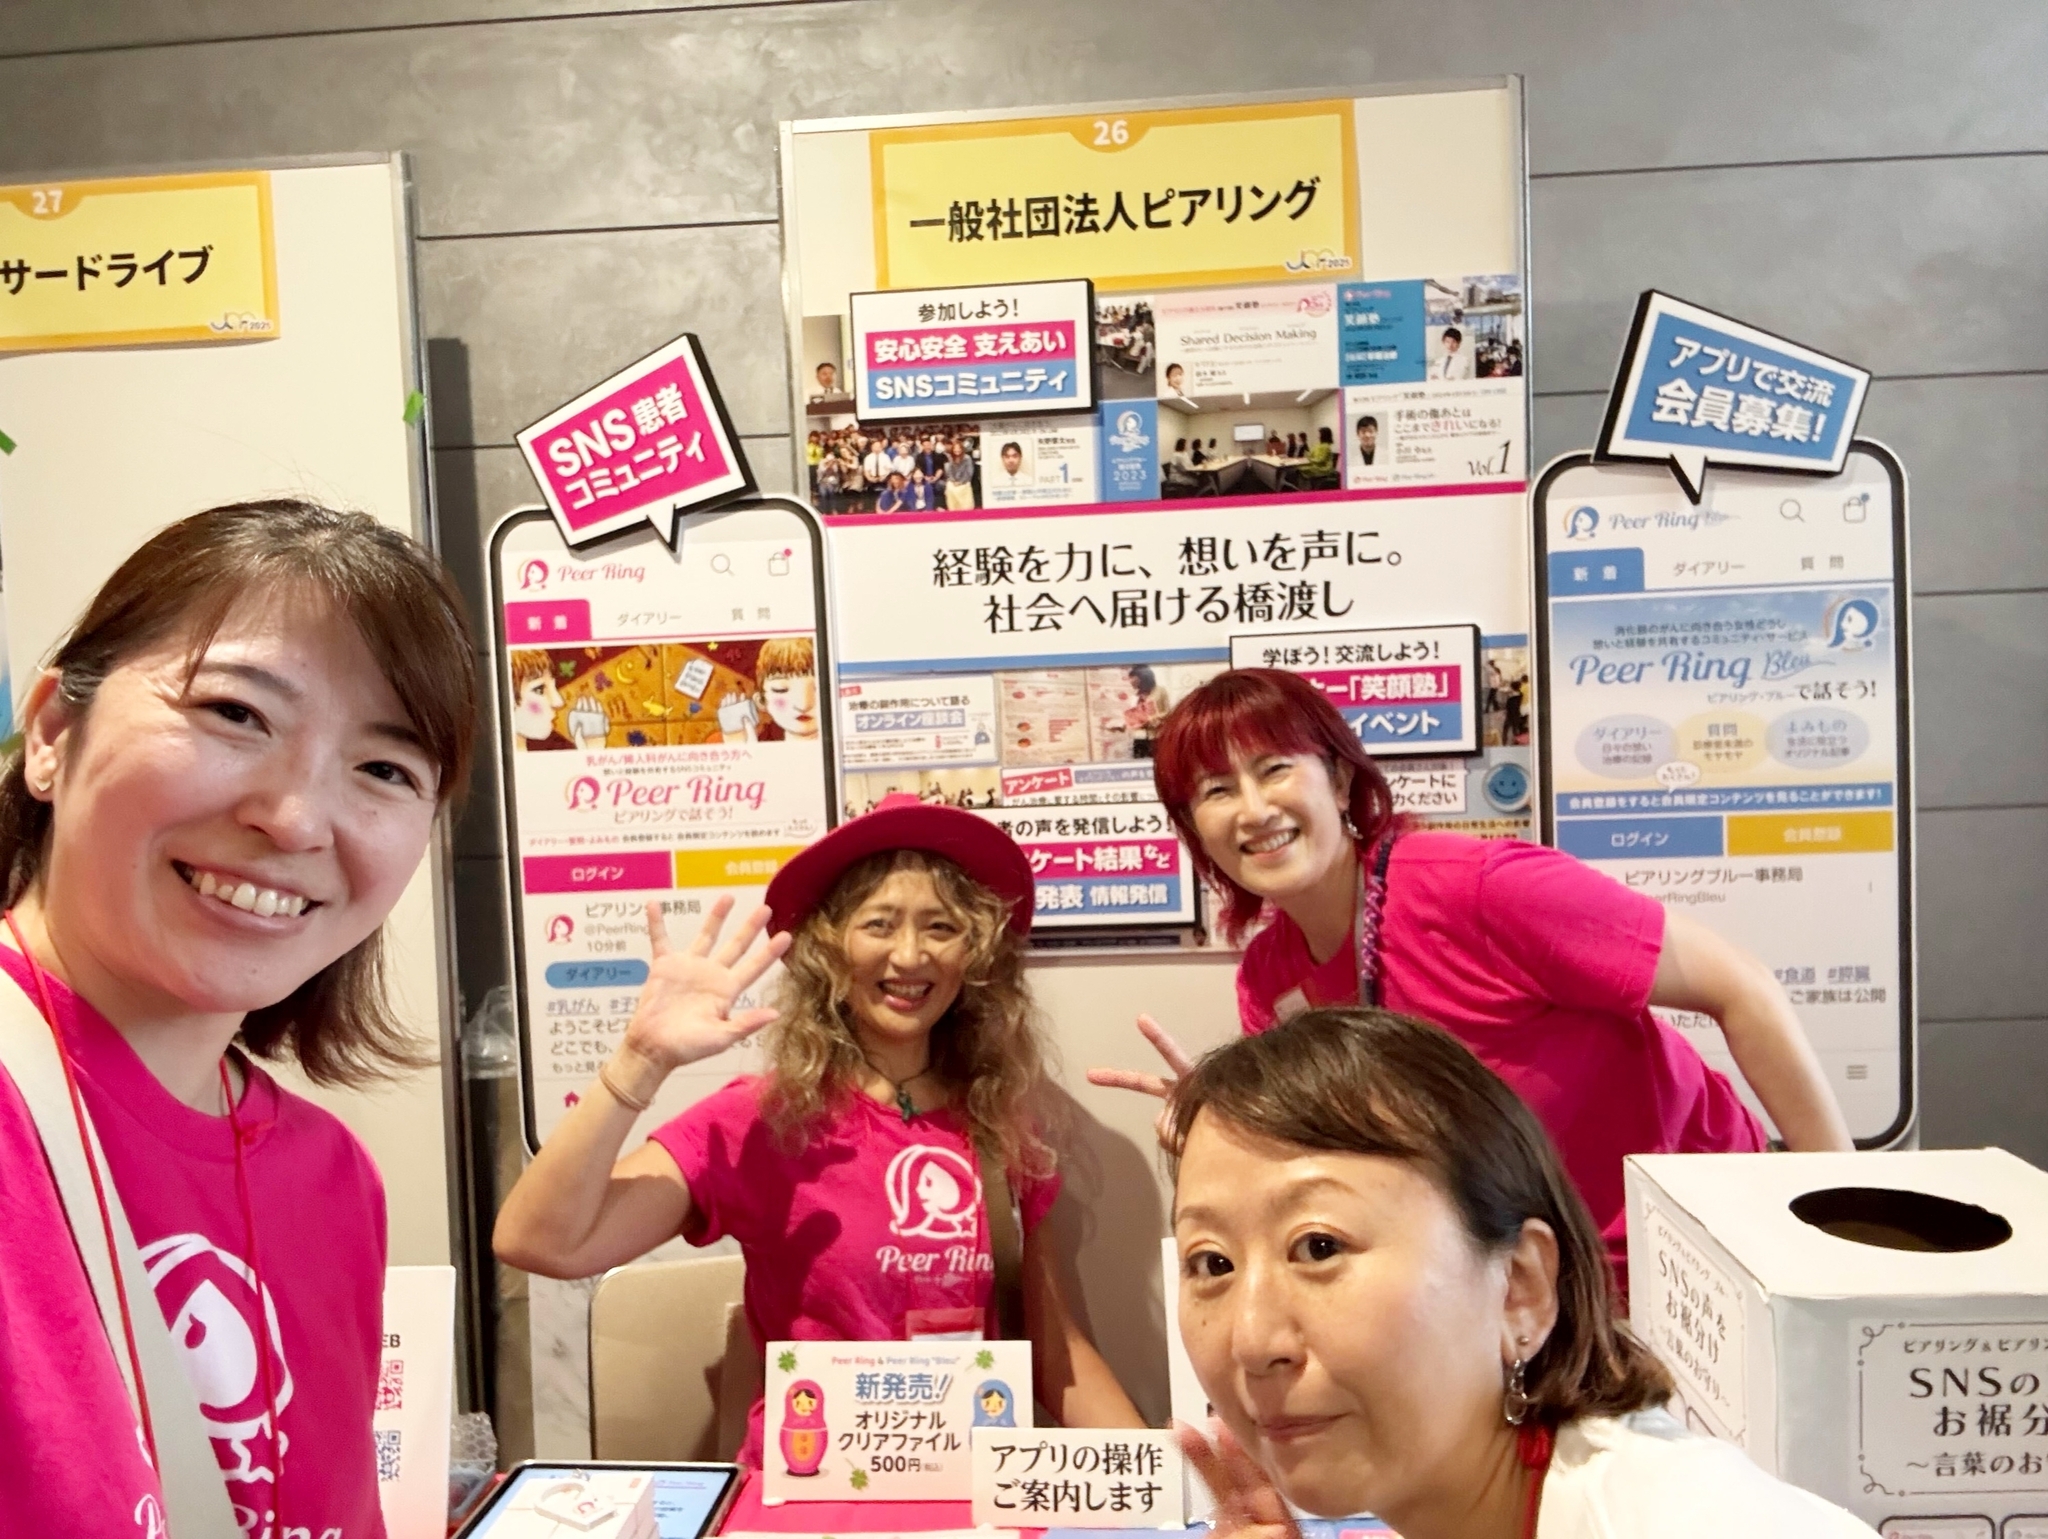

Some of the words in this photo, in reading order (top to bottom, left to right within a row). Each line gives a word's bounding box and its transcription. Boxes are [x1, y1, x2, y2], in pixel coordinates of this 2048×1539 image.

[1093, 120, 1130, 147] 26
[32, 190, 63, 214] 27
[909, 177, 1322, 244] 一般社団法人ピアリング
[0, 244, 214, 296] サードライブ
[874, 334, 968, 364] 安心安全
[973, 330, 1067, 358] 支えあい
[1180, 334, 1220, 347] Shared
[1224, 331, 1273, 344] Decision
[1276, 329, 1317, 342] Making
[876, 368, 1068, 400] SNSコミュニティ
[1669, 335, 1837, 408] アプリで交流
[1651, 378, 1827, 443] 会員募集！
[565, 430, 707, 511] コミュニティ
[1609, 513, 1651, 530] Peer
[1655, 510, 1699, 531] Ring
[557, 563, 598, 583] Peer
[601, 562, 646, 584] Ring
[933, 529, 1403, 590] 経験を力に、想いを声に。
[1673, 560, 1746, 577] ダイアリー
[617, 611, 682, 627] ダイアリー
[983, 579, 1354, 635] 社会へ届ける橋渡し
[1568, 653, 1655, 686] Peer
[1661, 650, 1752, 689] Ring
[606, 777, 681, 807] Peer
[686, 774, 766, 811] Ring
[1004, 771, 1070, 795] アンケート
[1611, 830, 1669, 848] ログイン
[1026, 844, 1171, 874] ケート結果など
[570, 865, 624, 883] ログイン
[586, 900, 702, 919] ピアリン事務局
[1035, 884, 1084, 910] 発表
[1090, 884, 1168, 907] 情報発信
[566, 966, 631, 983] ダイアリー
[875, 1244, 941, 1274] Peer
[855, 1411, 946, 1431] オリジナル
[838, 1432, 962, 1452] クリアファイル
[870, 1456, 921, 1473] 500円
[989, 1442, 1164, 1476] アプリの操作
[993, 1479, 1164, 1514] ご案内します
